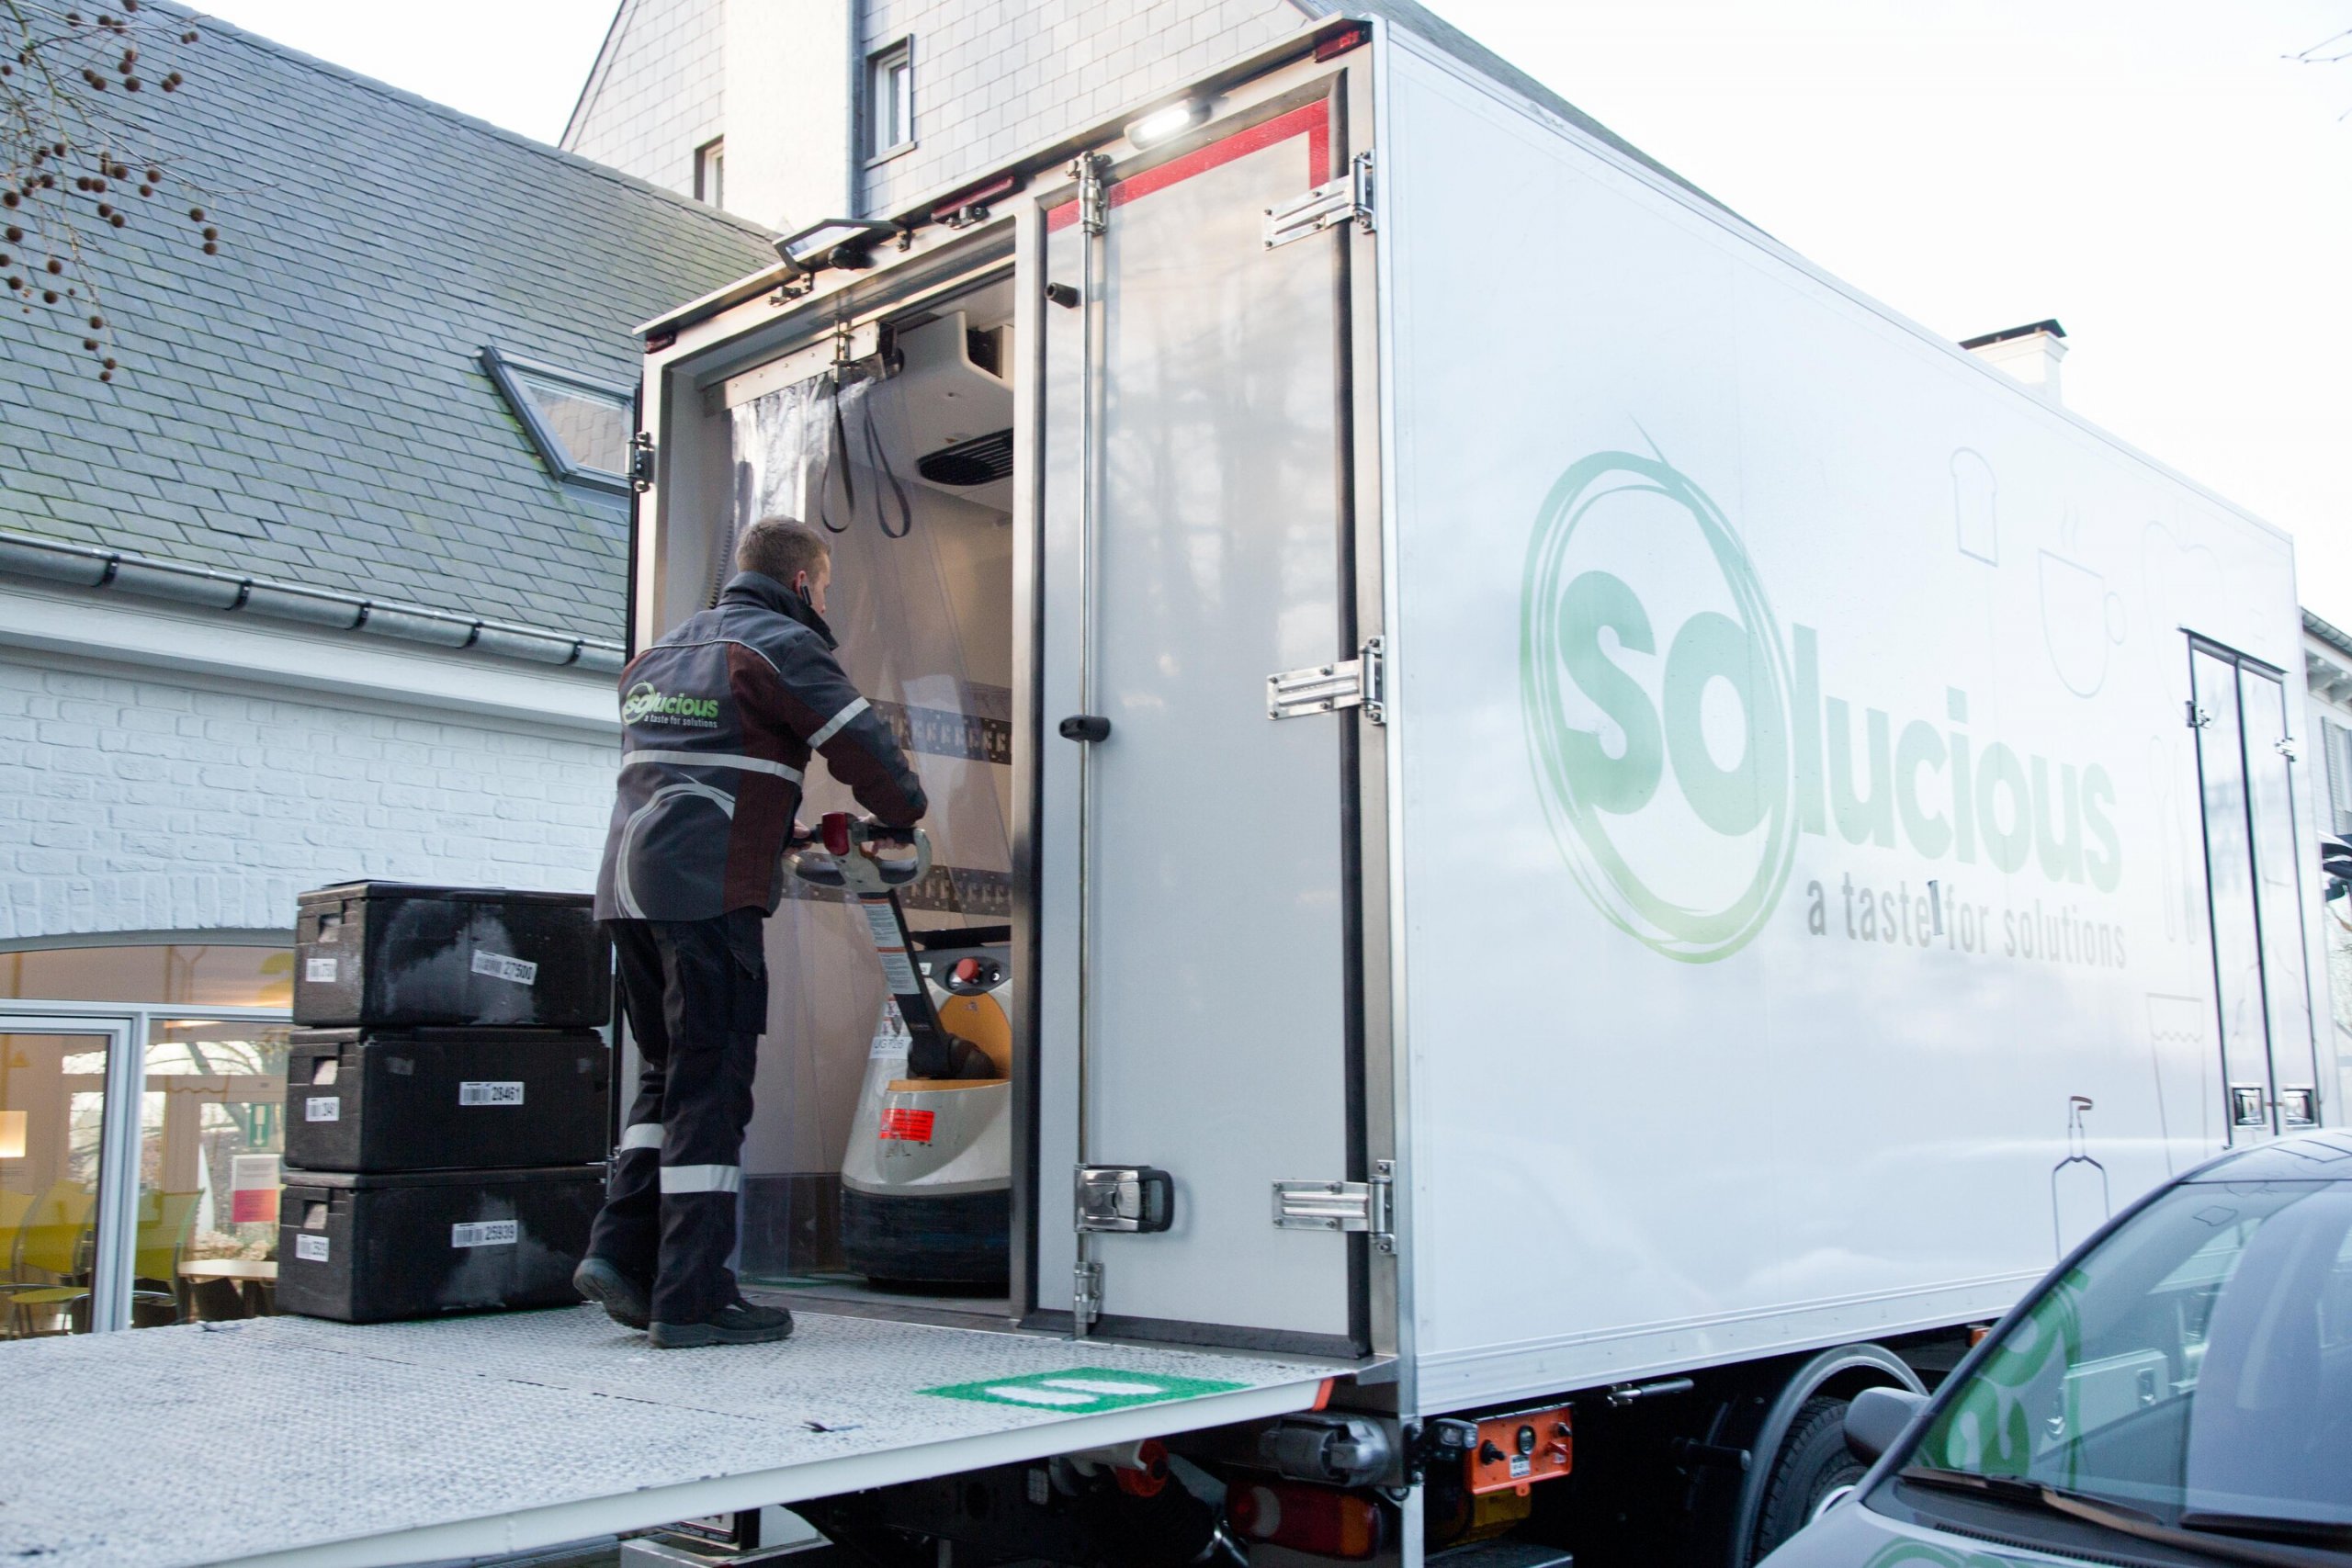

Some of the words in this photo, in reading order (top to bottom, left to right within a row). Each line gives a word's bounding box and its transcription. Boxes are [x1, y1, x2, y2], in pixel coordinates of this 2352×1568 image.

[624, 691, 719, 719] solucious
[650, 714, 669, 725] taste
[670, 716, 681, 725] for
[683, 719, 718, 728] solutions
[1560, 569, 2123, 895] solucious
[1806, 879, 1827, 937] a
[1841, 871, 1931, 948] taste
[1946, 884, 1990, 952] for
[2004, 897, 2128, 970] solutions
